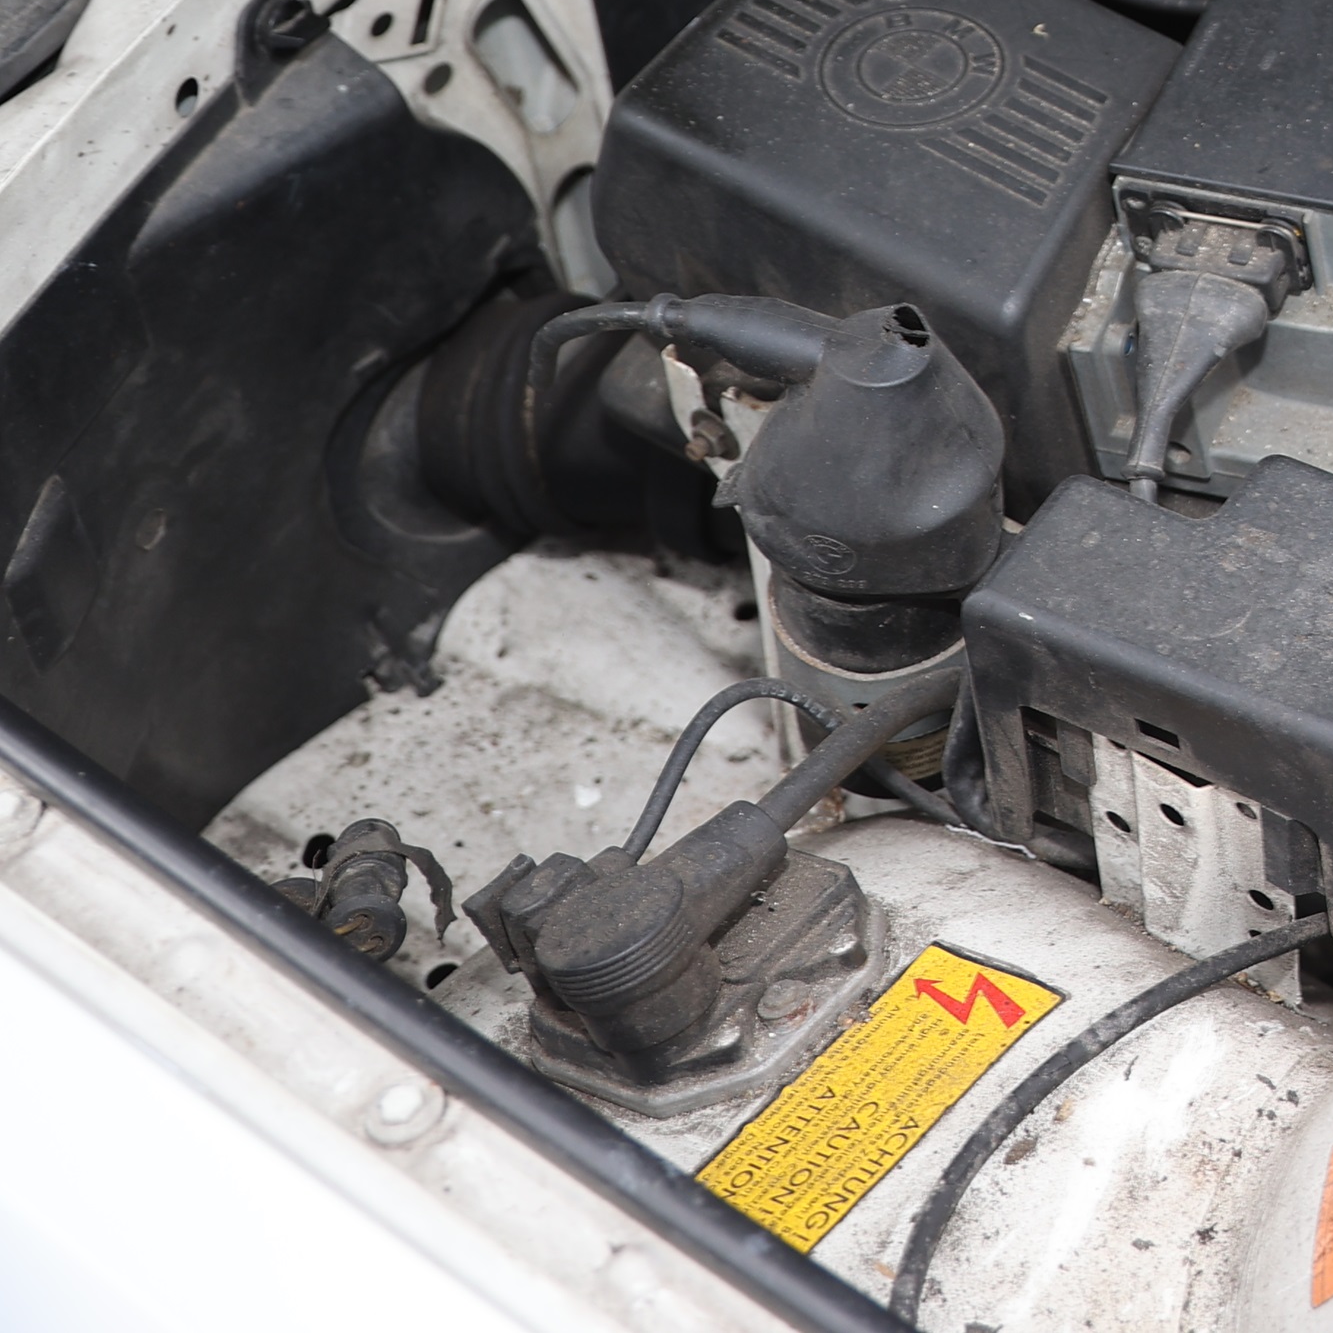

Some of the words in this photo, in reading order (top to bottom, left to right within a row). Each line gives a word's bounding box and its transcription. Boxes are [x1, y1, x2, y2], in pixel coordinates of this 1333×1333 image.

[886, 15, 994, 77] BMW
[769, 1100, 880, 1204] CAUTION
[801, 1115, 920, 1235] ACHTUNG
